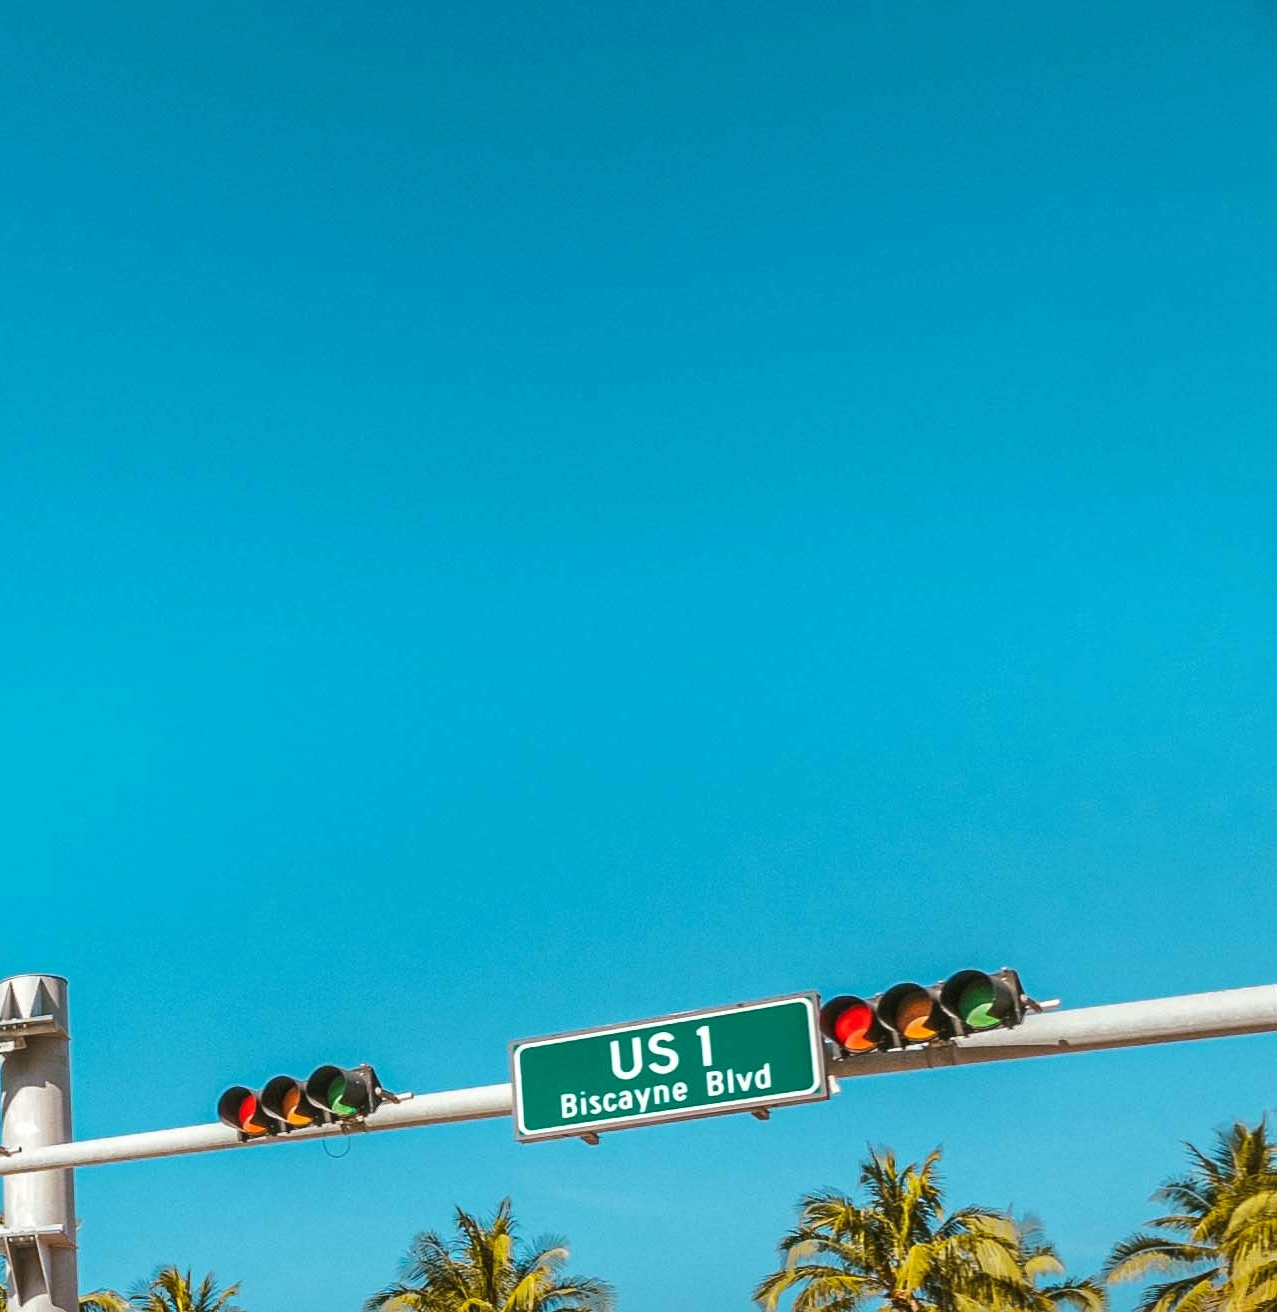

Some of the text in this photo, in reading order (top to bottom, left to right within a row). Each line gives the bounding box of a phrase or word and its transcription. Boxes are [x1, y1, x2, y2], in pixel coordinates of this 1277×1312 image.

[610, 1025, 714, 1081] US 1
[559, 1063, 772, 1119] Biscayne Blvd
